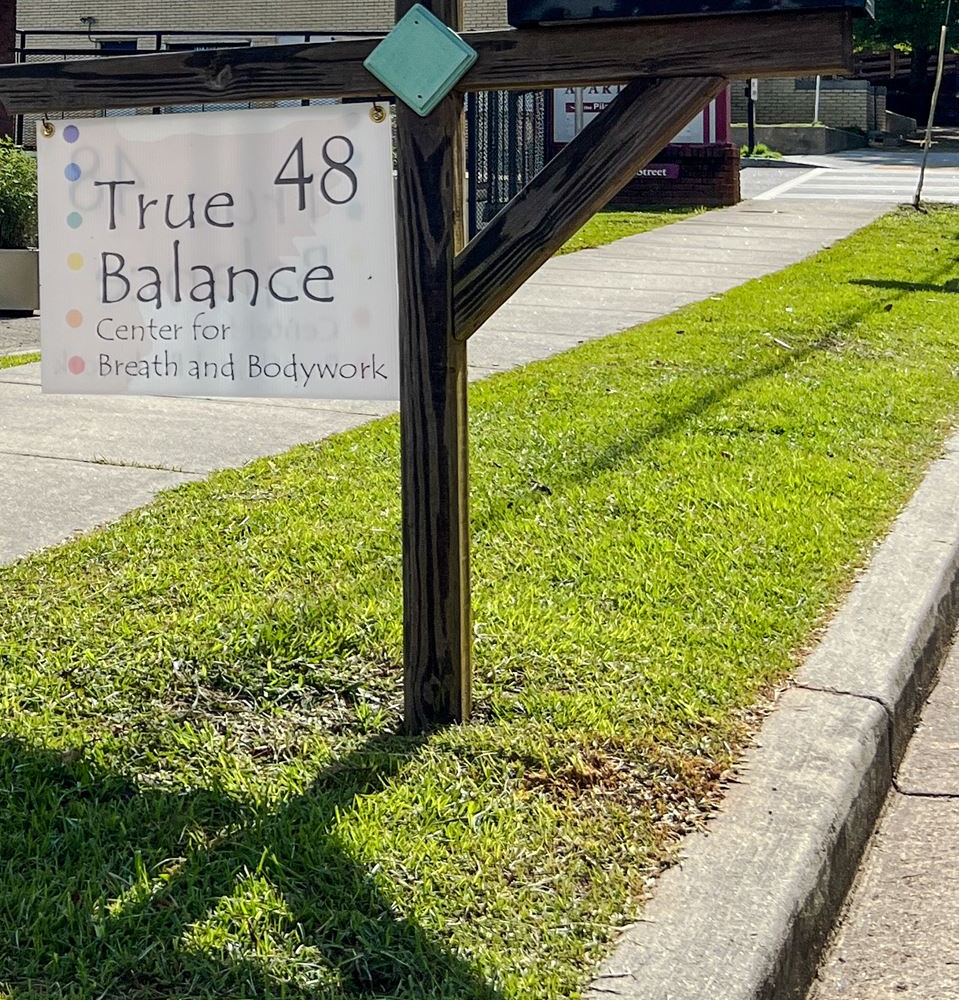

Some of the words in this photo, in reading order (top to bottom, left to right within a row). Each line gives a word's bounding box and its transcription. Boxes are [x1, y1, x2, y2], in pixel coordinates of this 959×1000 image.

[274, 136, 357, 211] 48
[94, 181, 234, 230] True
[102, 240, 334, 309] Balance
[97, 318, 182, 341] Center
[193, 312, 230, 340] for
[100, 350, 177, 378] Breath
[189, 353, 234, 380] and
[249, 354, 387, 387] Bodywork
